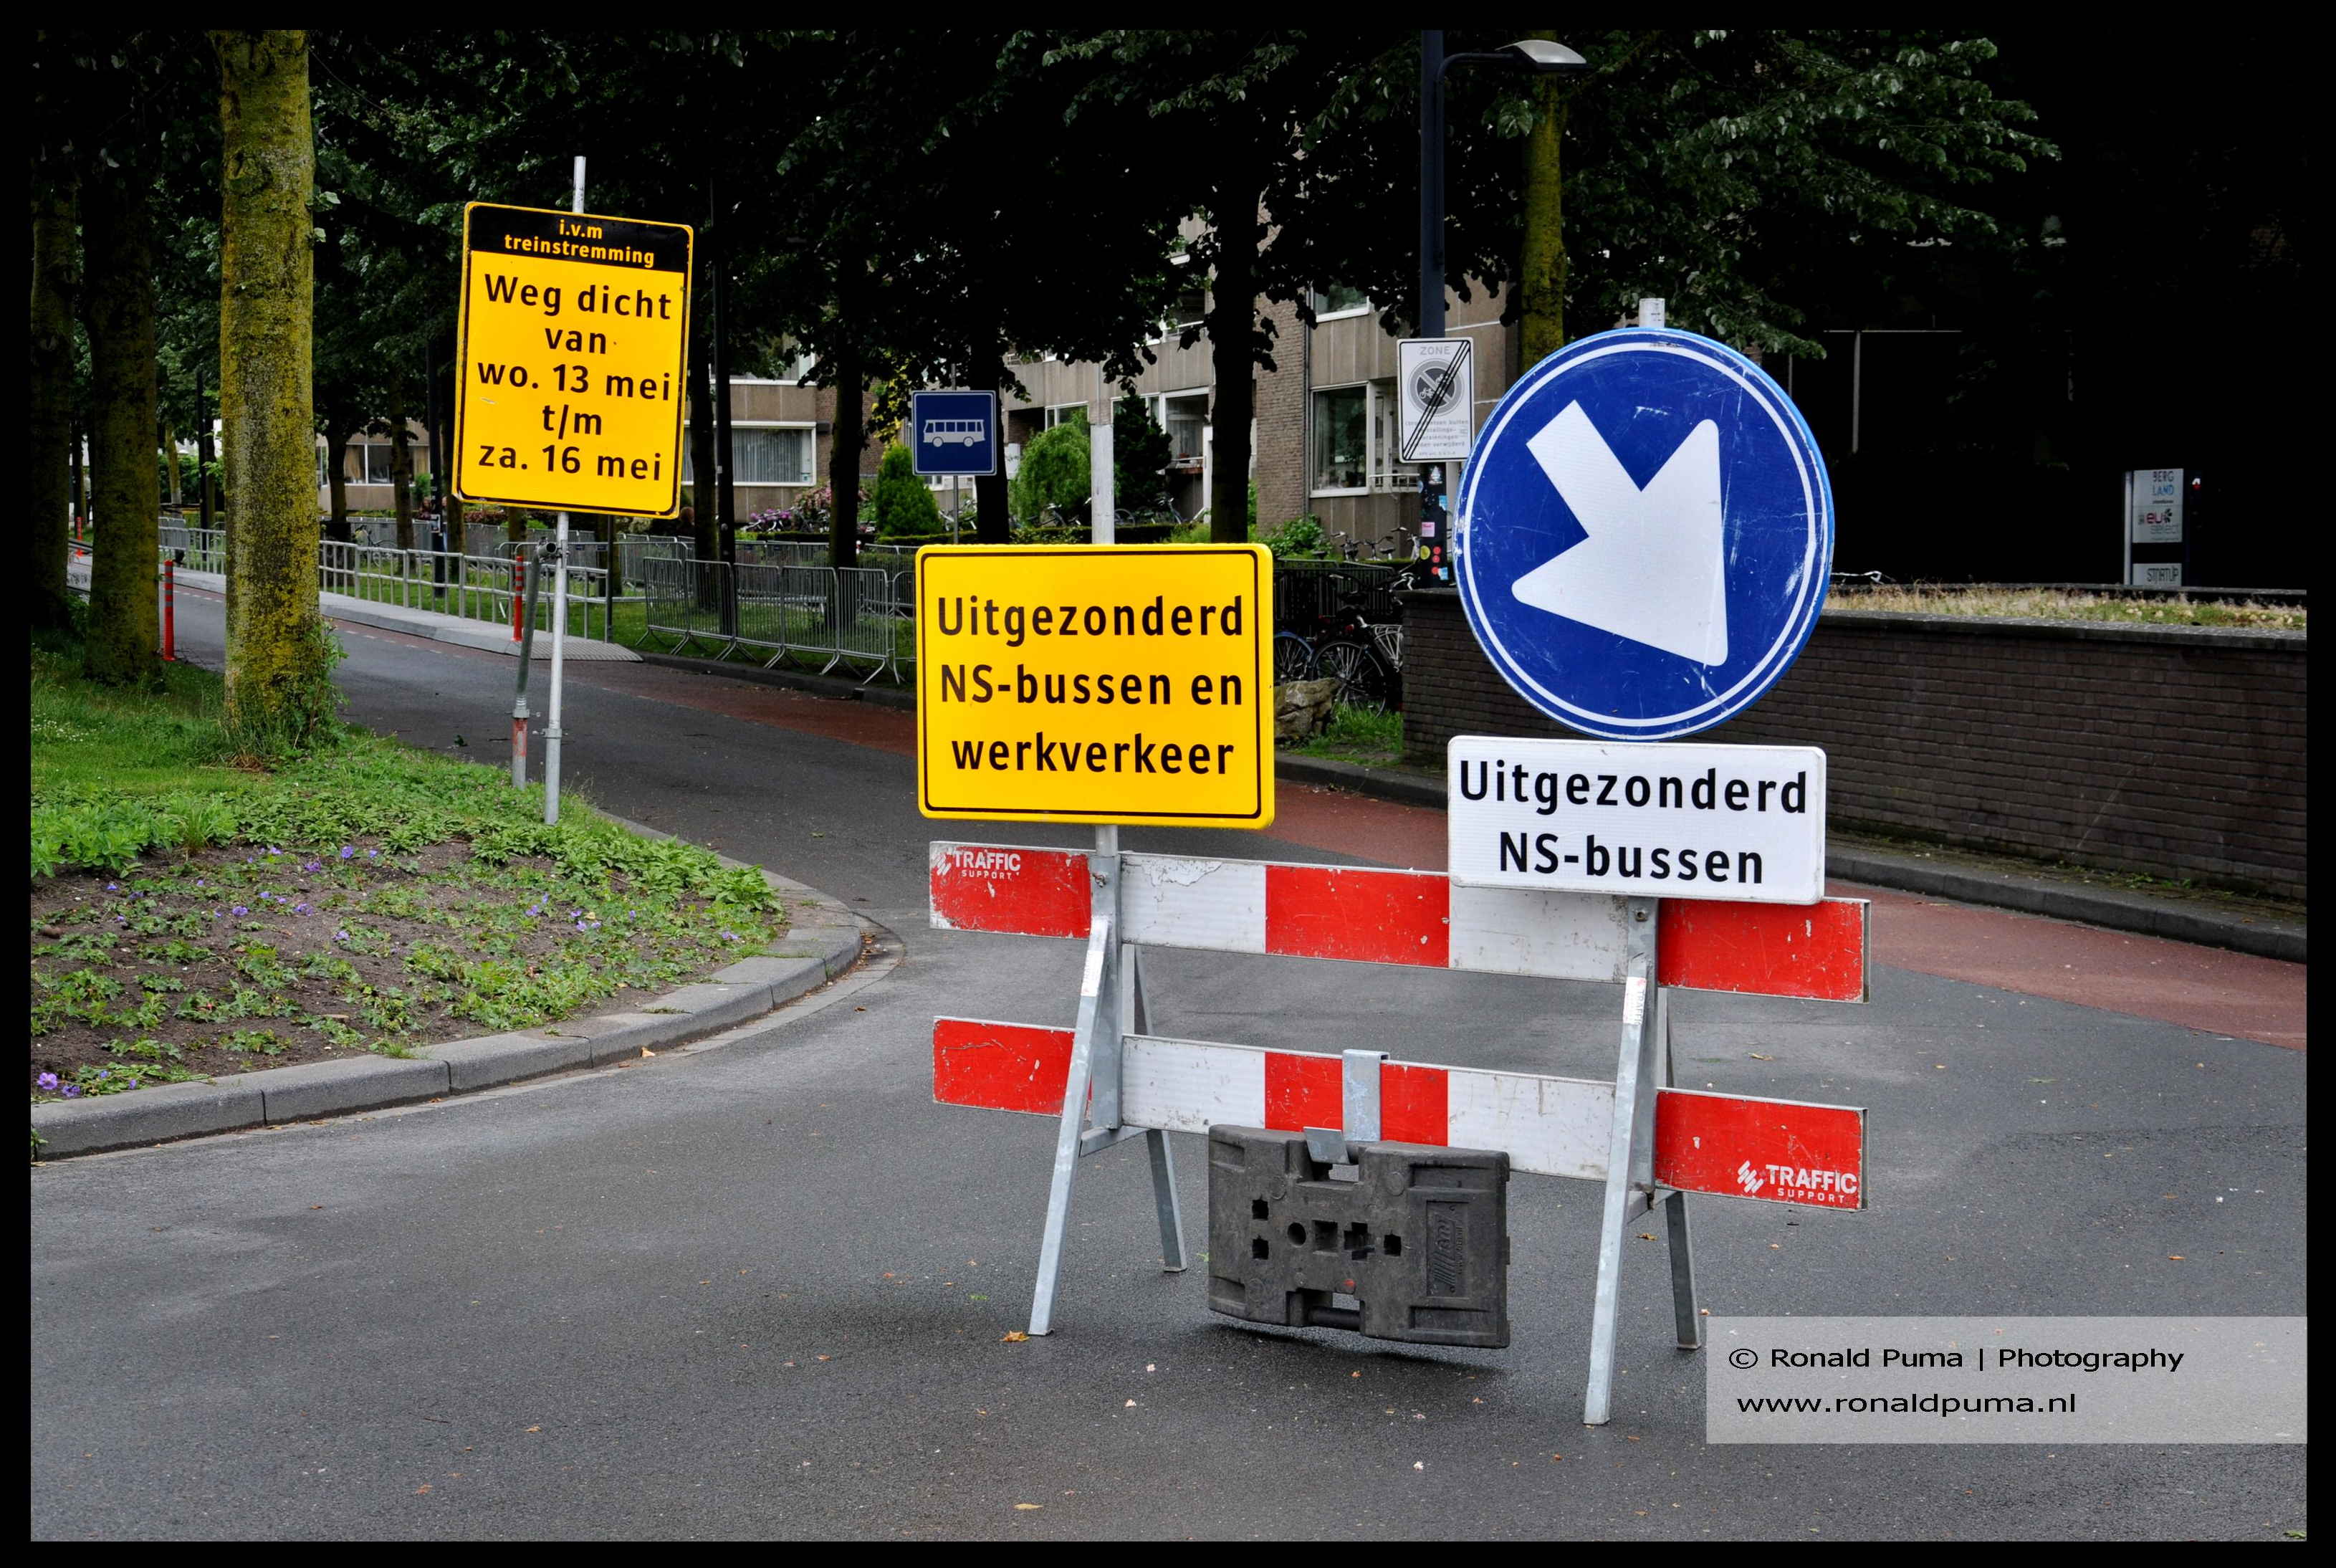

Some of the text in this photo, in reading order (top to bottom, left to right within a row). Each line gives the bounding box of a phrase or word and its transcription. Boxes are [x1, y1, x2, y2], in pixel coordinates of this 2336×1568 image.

[559, 219, 602, 239] i.v.m
[504, 234, 654, 268] treinstremming
[484, 273, 671, 320] Weg dicht
[545, 328, 606, 355] van
[1419, 345, 1451, 355] ZONE
[477, 362, 670, 401] wo. 13 mei
[542, 404, 602, 440] t/m
[479, 444, 661, 481] za. 16 mei
[2153, 471, 2174, 482] BERG
[2152, 484, 2174, 496] LAND
[939, 595, 1243, 647] Uitgezonderd
[942, 664, 1242, 705] NS-bussen en
[952, 731, 1234, 775] werkverkeer
[1460, 759, 1806, 816] Uitgezonderd
[954, 851, 1020, 872] TRAFFIC
[961, 869, 1012, 880] SUPPORT
[1500, 831, 1762, 884] NS-bussen
[1766, 1164, 1857, 1194] TRAFFIC
[1778, 1187, 1845, 1204] SUPPORT
